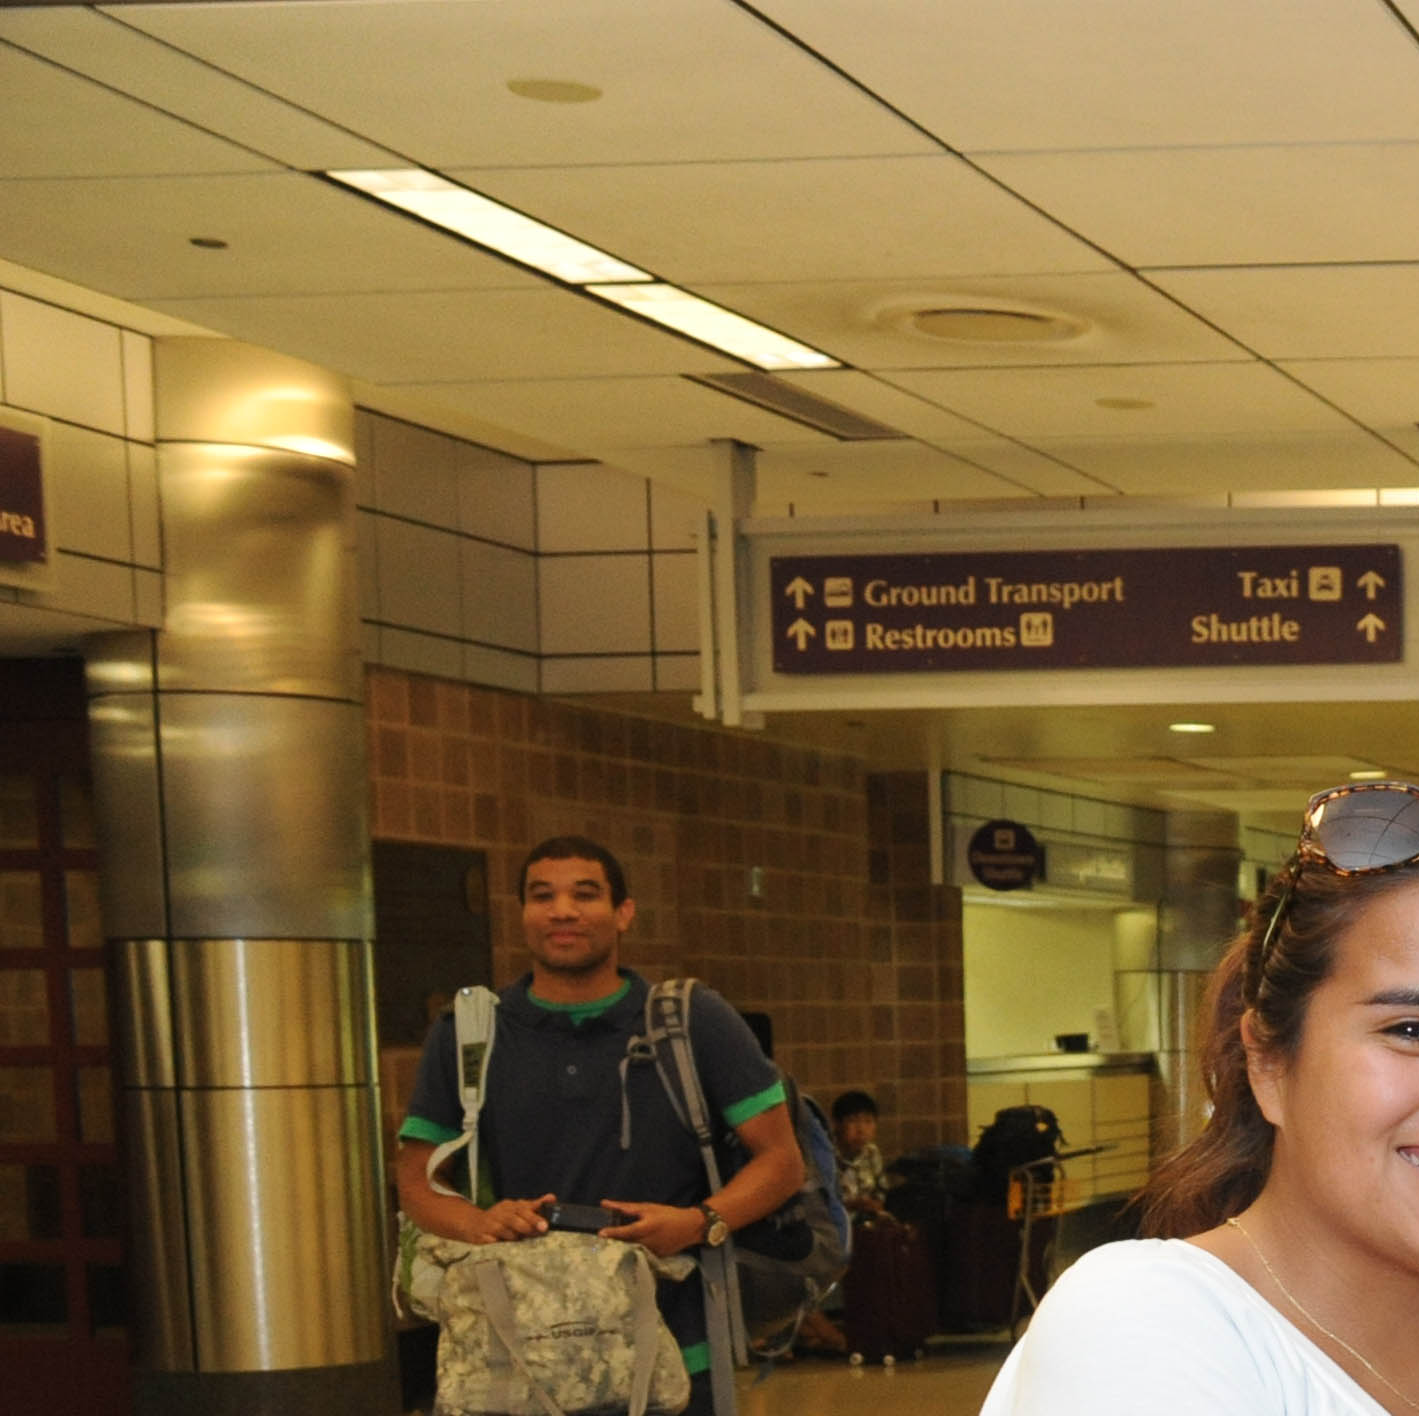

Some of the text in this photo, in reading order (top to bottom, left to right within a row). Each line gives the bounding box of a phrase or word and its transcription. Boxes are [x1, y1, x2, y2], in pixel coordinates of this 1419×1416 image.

[0, 511, 36, 539] rea
[864, 574, 1125, 609] Ground Transport
[1238, 570, 1299, 600] Taxi
[864, 621, 1016, 651] Restrooms
[1191, 614, 1300, 644] Shuttle
